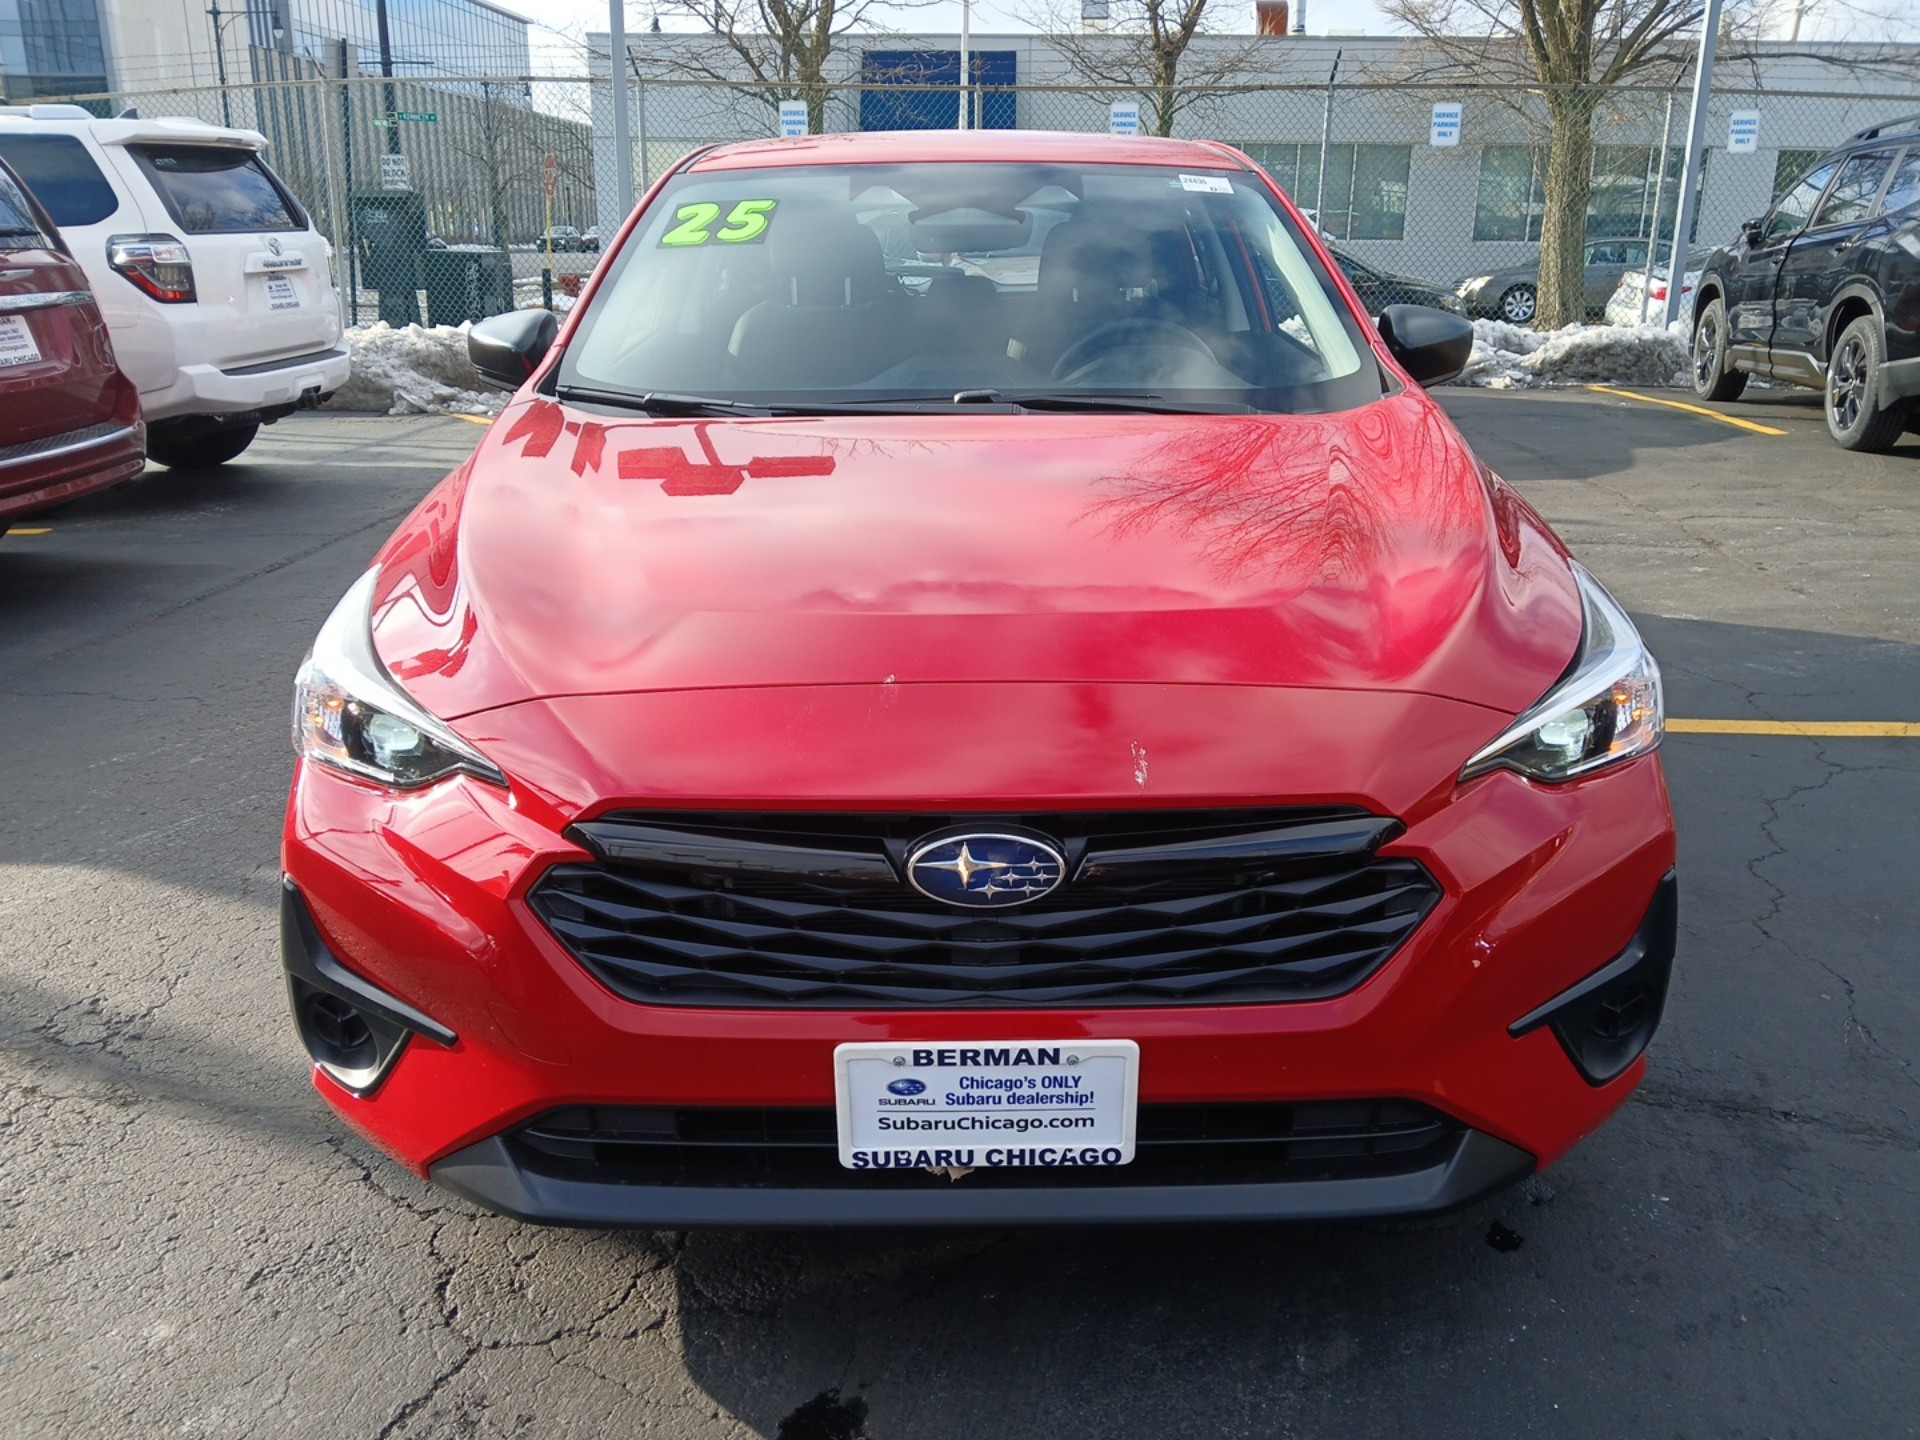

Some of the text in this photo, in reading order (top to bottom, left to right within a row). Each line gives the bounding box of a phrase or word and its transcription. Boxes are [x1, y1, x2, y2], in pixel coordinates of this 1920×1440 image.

[392, 157, 405, 166] NOT
[383, 169, 406, 177] BLOCK
[661, 199, 776, 245] 25
[913, 1047, 1060, 1067] BERMAN
[1041, 1075, 1082, 1089] ONLY
[878, 1098, 936, 1106] SUBARU
[945, 1091, 1095, 1106] Subaru dealership!
[878, 1116, 1095, 1133] SubaruChicago.com
[852, 1147, 1122, 1168] SUBARU CHICAGO
